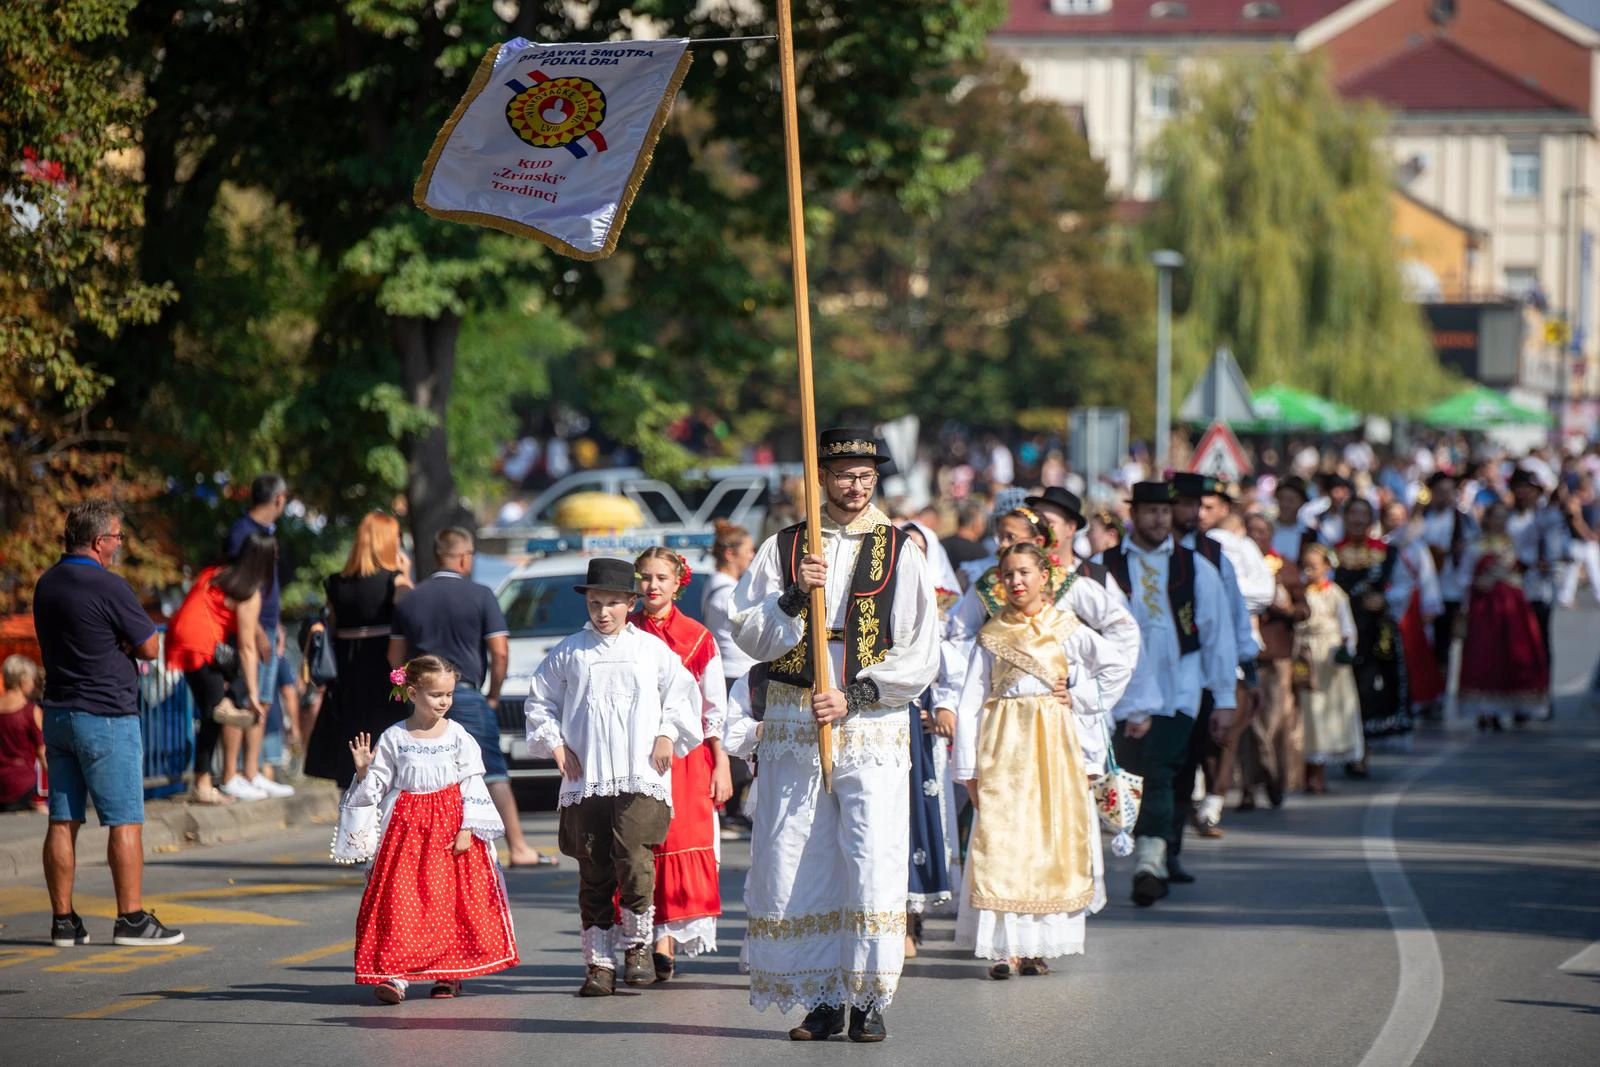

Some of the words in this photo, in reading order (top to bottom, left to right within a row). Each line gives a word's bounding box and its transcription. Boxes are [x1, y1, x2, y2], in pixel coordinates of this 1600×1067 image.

[518, 49, 586, 64] DRŽAVNA
[590, 48, 654, 58] SMOTRA
[540, 57, 619, 67] FOLKLORA
[540, 124, 560, 133] LVIII
[517, 158, 553, 169] KUD
[491, 180, 559, 203] Tordinci
